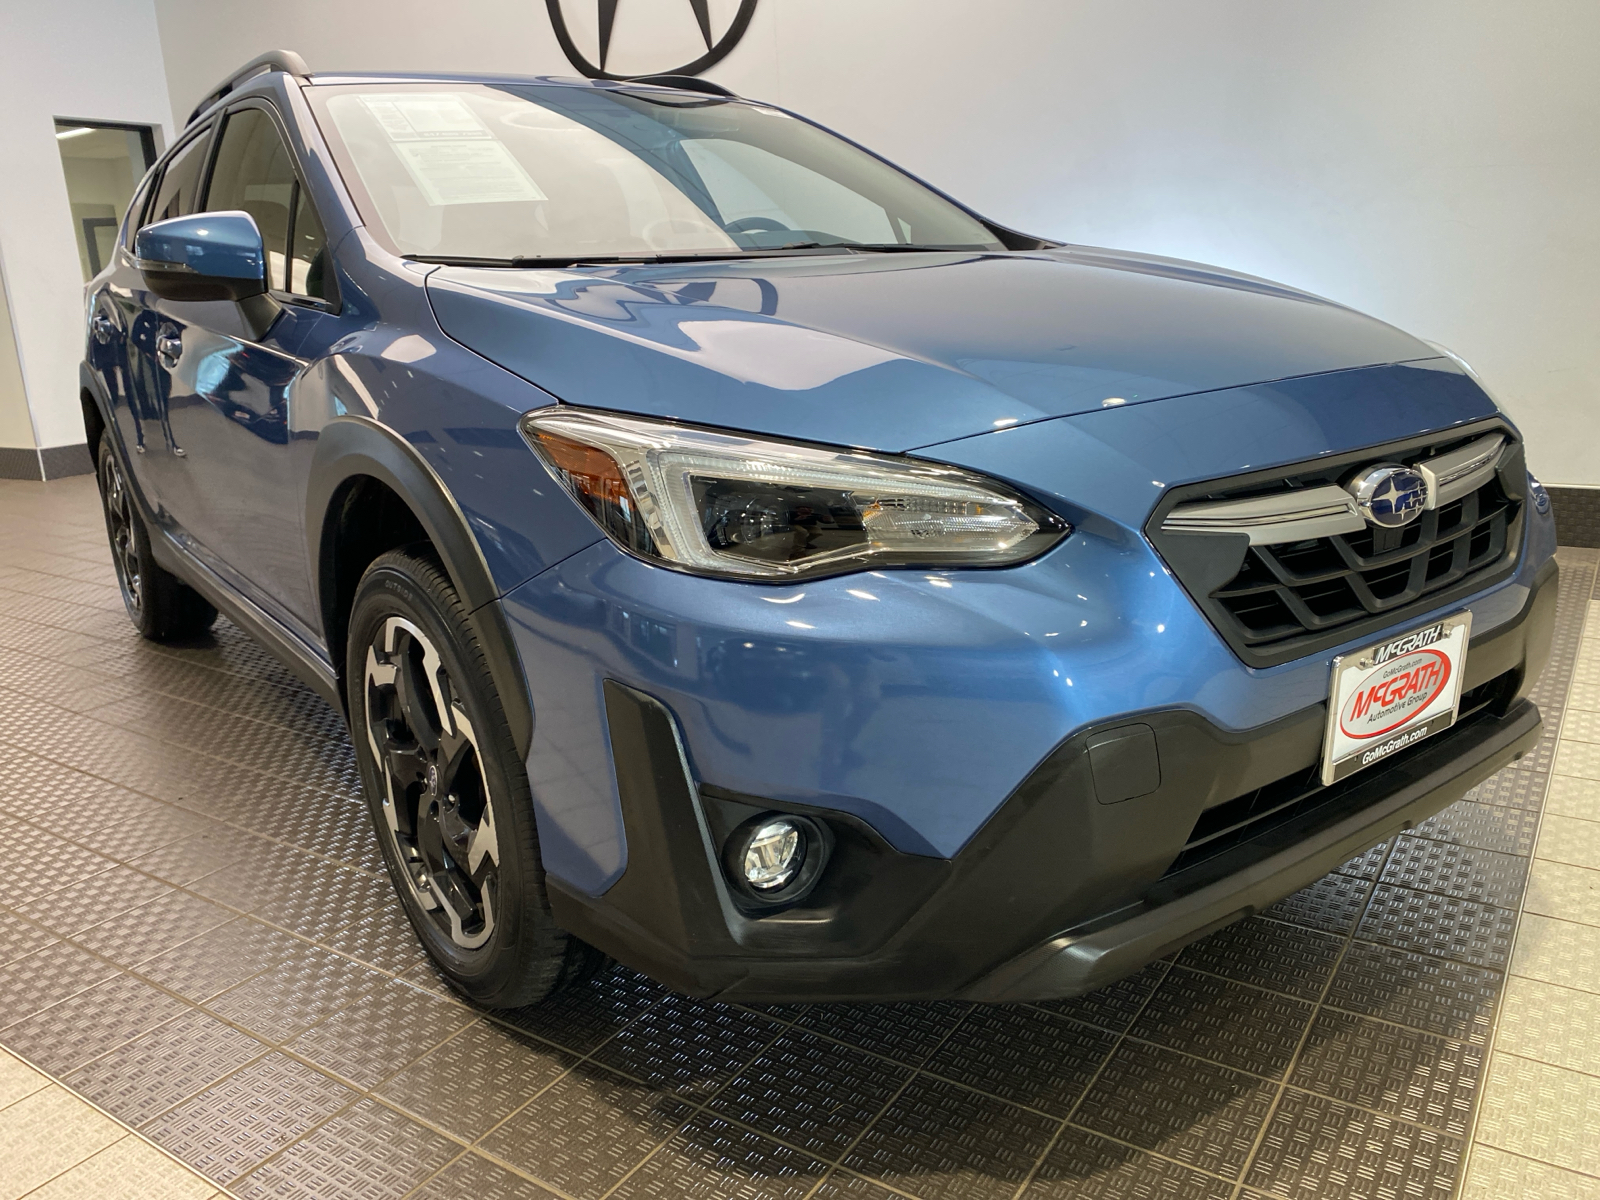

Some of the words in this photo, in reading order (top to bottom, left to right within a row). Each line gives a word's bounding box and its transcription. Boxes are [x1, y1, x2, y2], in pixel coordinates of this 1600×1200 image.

[1382, 658, 1423, 679] GoMcGrath.com
[1367, 701, 1406, 724] Automotive
[1407, 692, 1428, 707] Group
[1362, 727, 1428, 765] GoMcGrath.com
